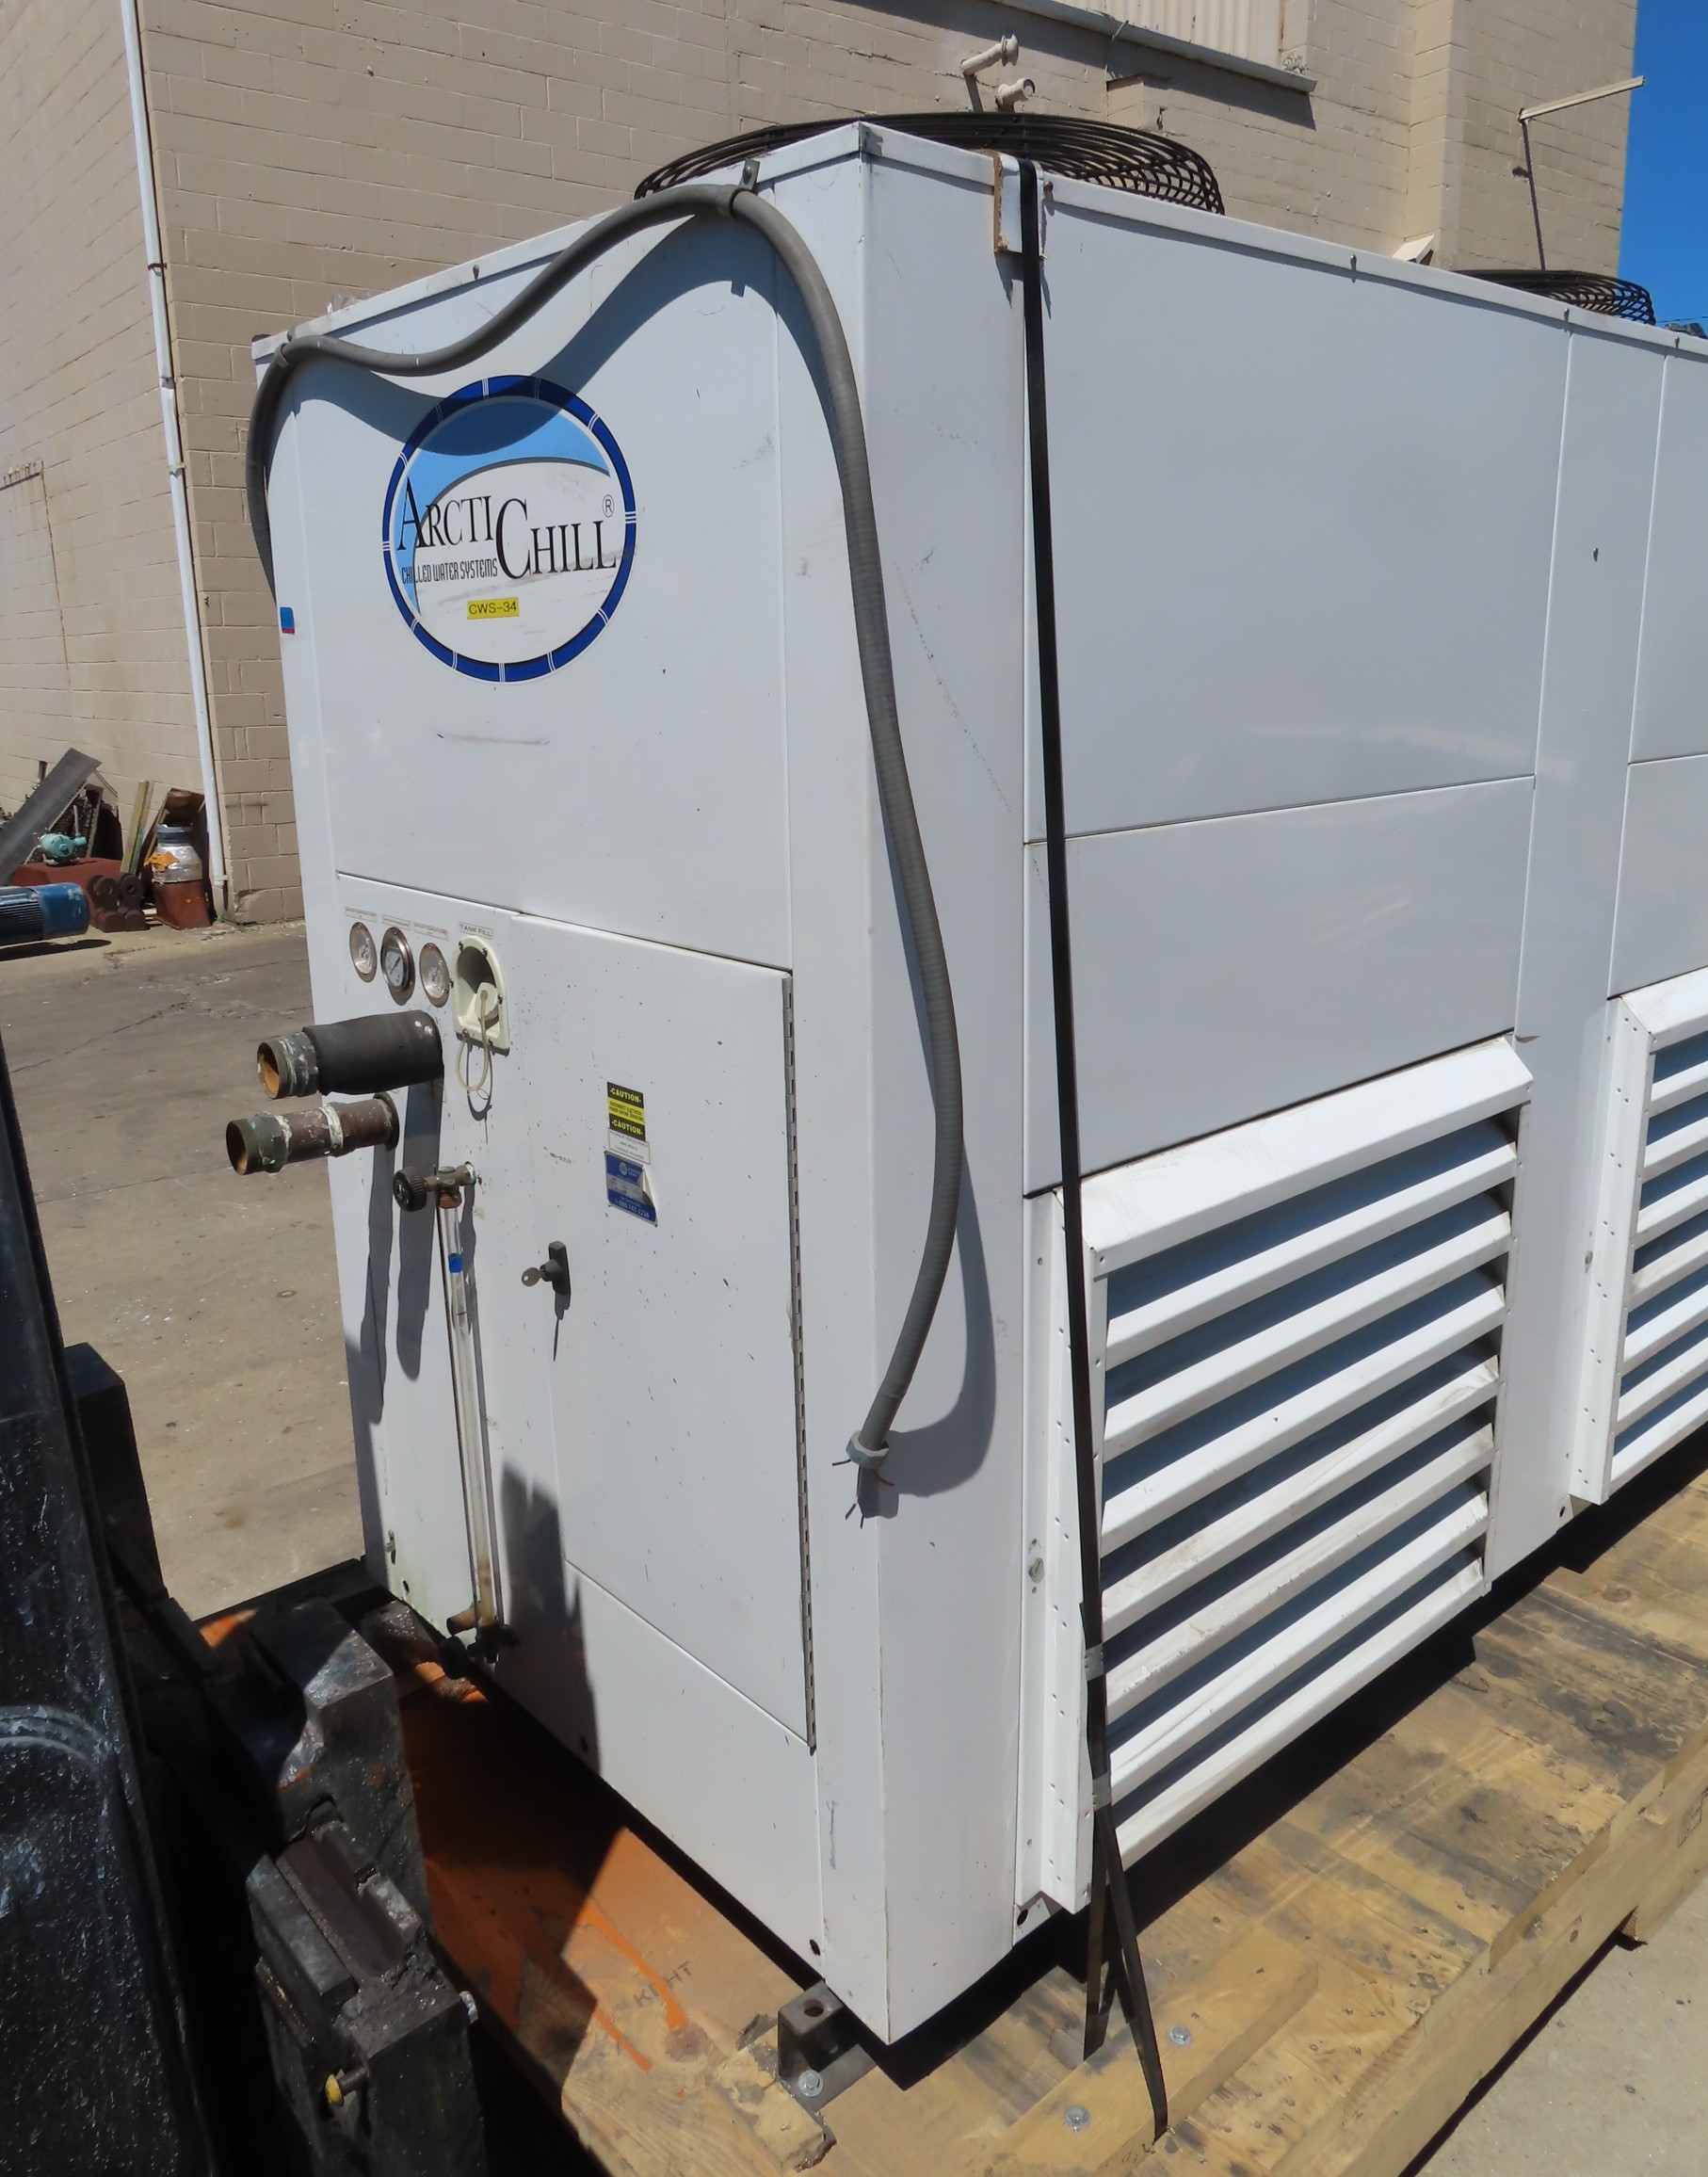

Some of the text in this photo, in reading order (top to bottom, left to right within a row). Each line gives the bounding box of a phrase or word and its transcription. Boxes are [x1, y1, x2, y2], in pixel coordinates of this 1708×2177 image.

[401, 557, 498, 585] CHILLED WATER SYSTEMS
[468, 601, 518, 616] CWS-34
[460, 924, 491, 937] TANK FILL
